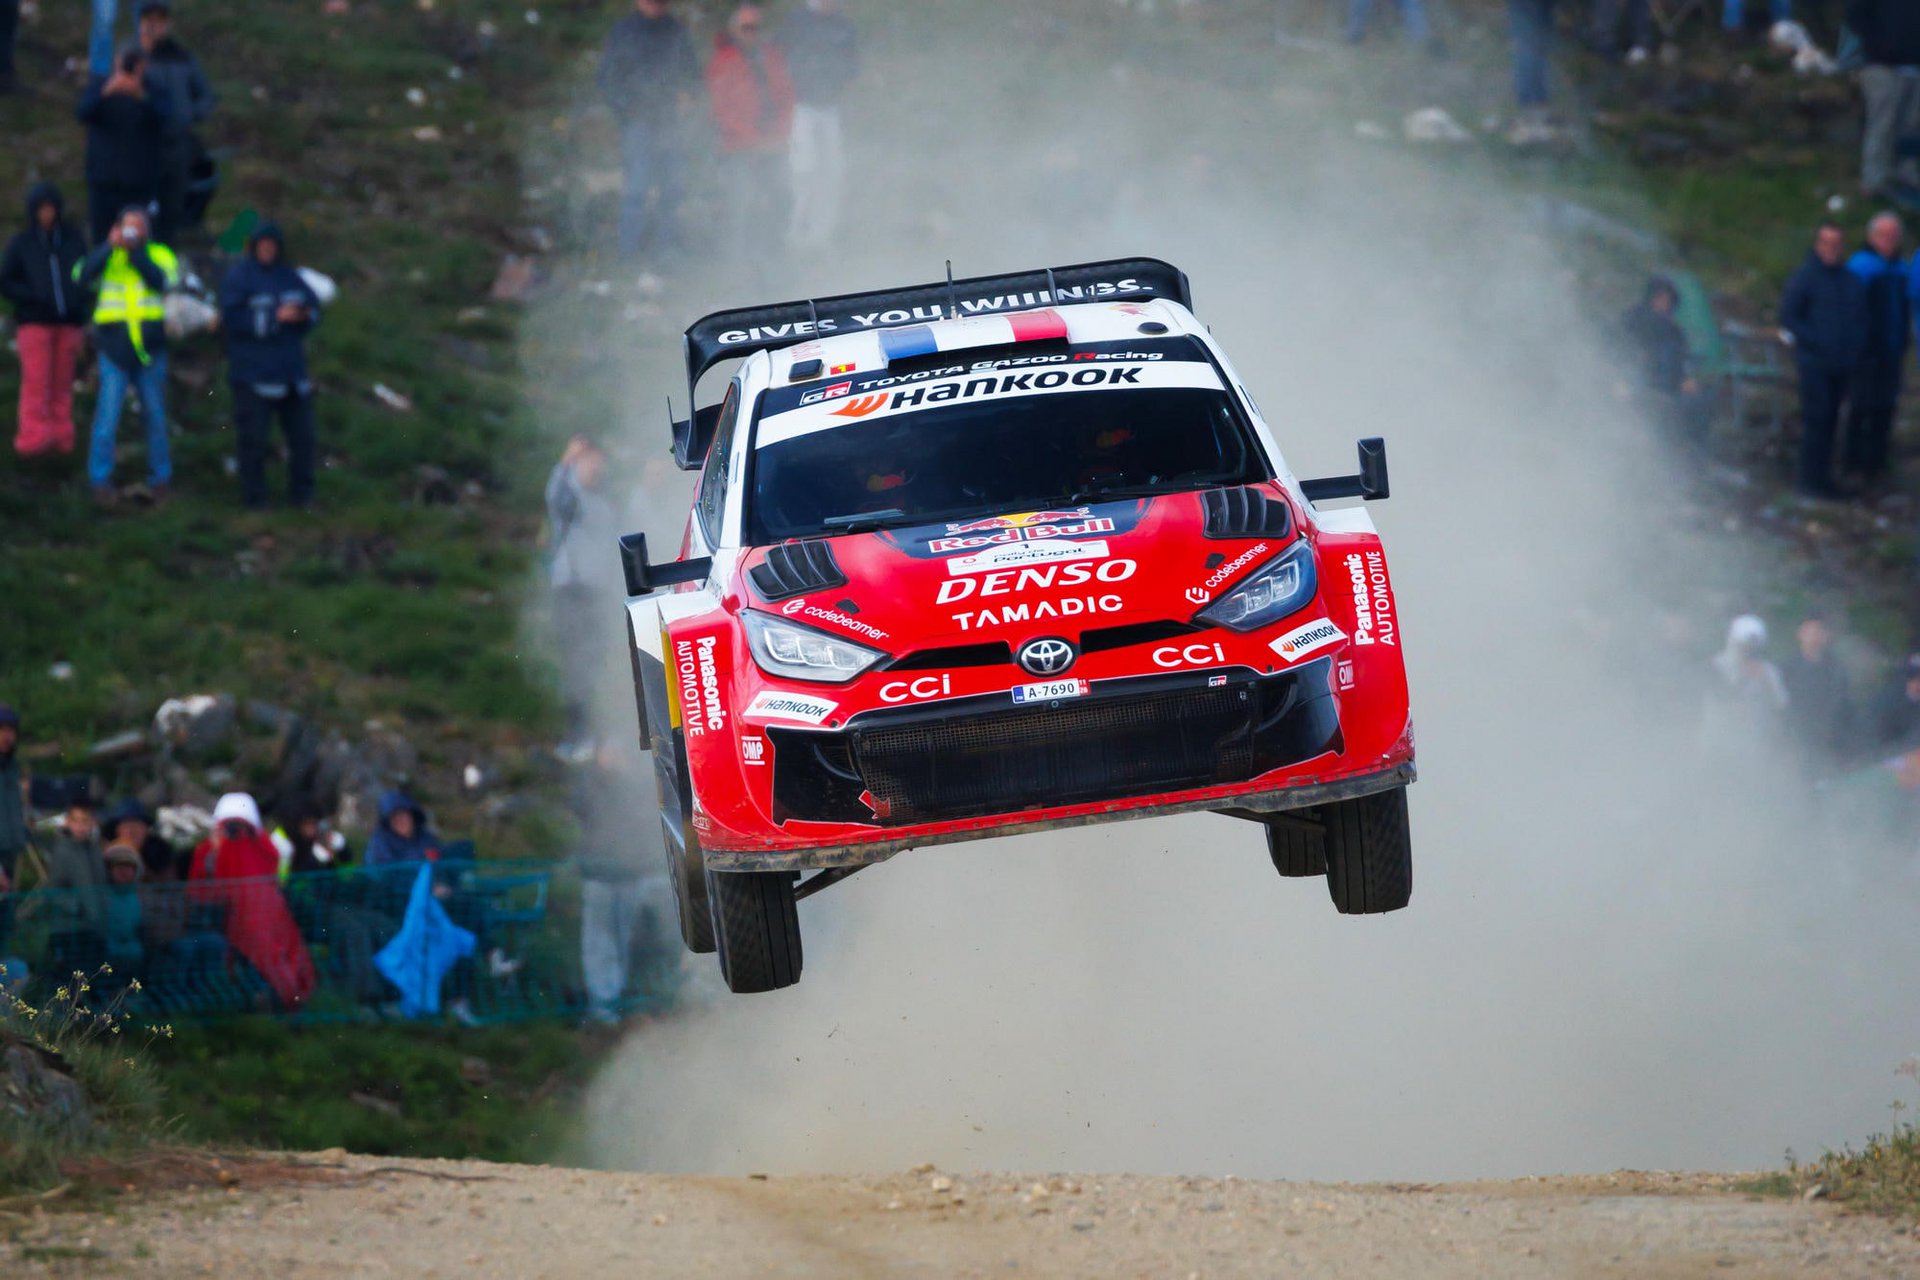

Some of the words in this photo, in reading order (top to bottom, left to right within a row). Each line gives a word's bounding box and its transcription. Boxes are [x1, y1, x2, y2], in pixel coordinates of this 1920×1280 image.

[718, 319, 837, 344] GIVES
[851, 305, 943, 326] YOU
[801, 384, 849, 404] GR
[858, 365, 963, 389] TOYOTA
[969, 354, 1067, 371] GAZOO
[1073, 351, 1163, 361] Racing
[929, 528, 1021, 553] Red
[1024, 518, 1115, 540] Bull
[935, 559, 1137, 605] DENSO
[1206, 542, 1268, 588] codebeamer
[951, 594, 1123, 631] TAMADIC
[1343, 553, 1375, 646] Panasonic
[1366, 551, 1395, 646] AUTOMOTIVE
[804, 604, 887, 640] codebeamer
[677, 640, 704, 738] AUTOMOTIVE
[696, 635, 727, 731] Panasonic
[1028, 682, 1075, 698] A-7690
[742, 741, 764, 760] OMP
